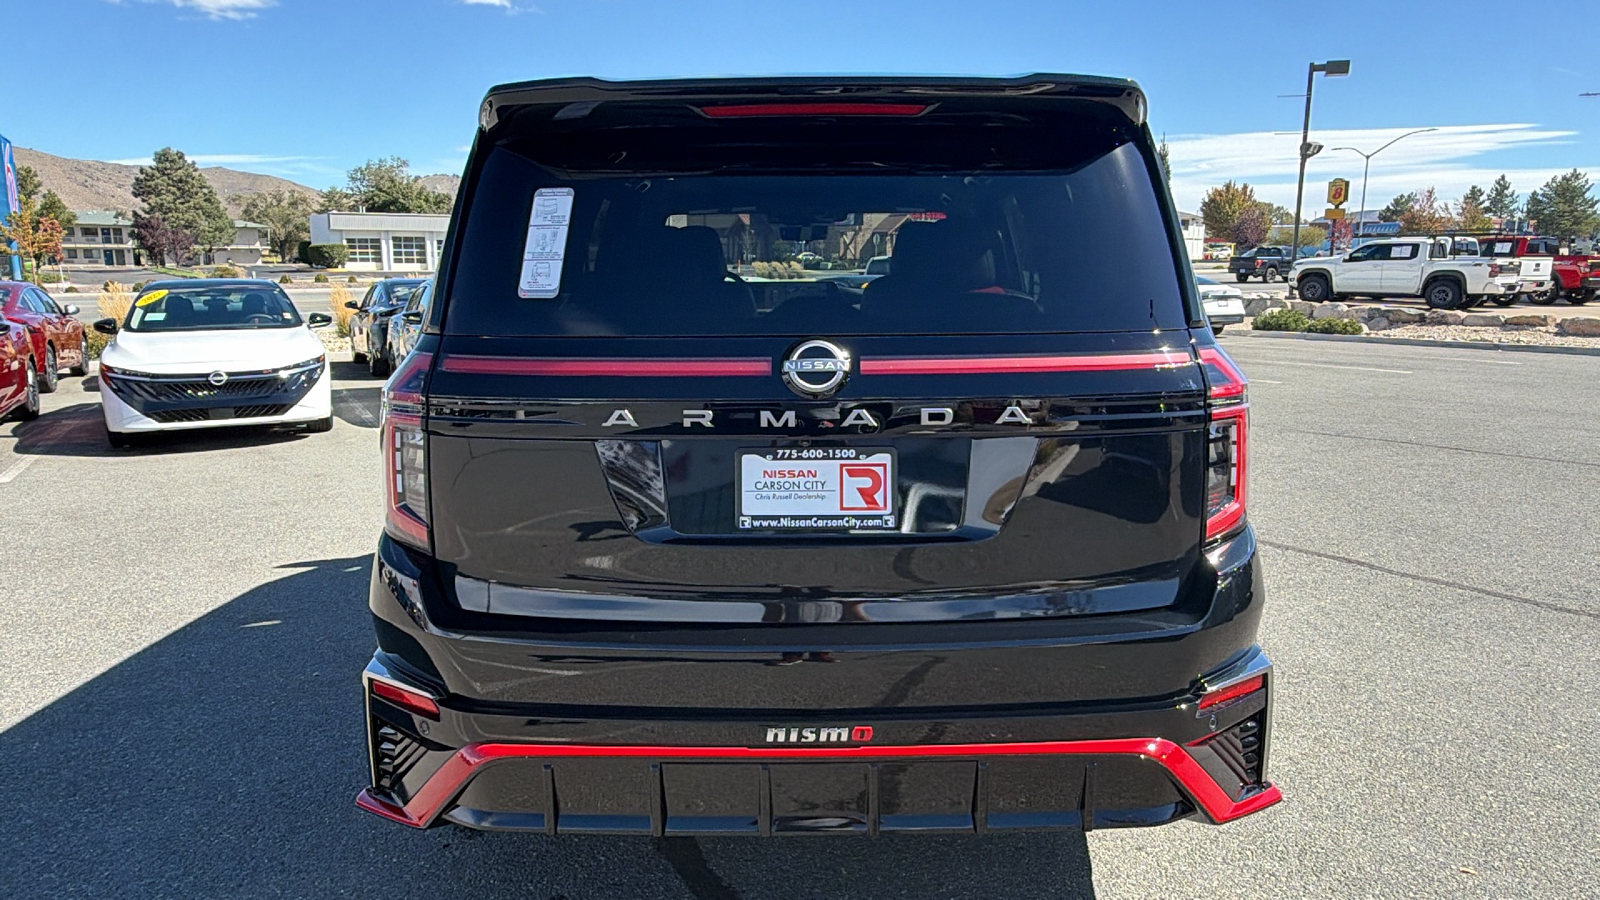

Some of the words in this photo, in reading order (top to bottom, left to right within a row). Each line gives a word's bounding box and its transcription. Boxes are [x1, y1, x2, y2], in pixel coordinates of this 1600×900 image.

[1332, 186, 1344, 200] 8
[785, 361, 847, 370] NISSAN
[601, 406, 1033, 428] ARMADA
[776, 449, 856, 459] 775-600-1500
[762, 469, 818, 479] NISSAN
[754, 480, 801, 491] CARSON
[803, 480, 827, 490] CITY
[845, 468, 883, 508] R
[754, 493, 771, 501] Chris
[793, 492, 827, 501] Dealership
[752, 516, 883, 529] www.NissanCarsonCity.com
